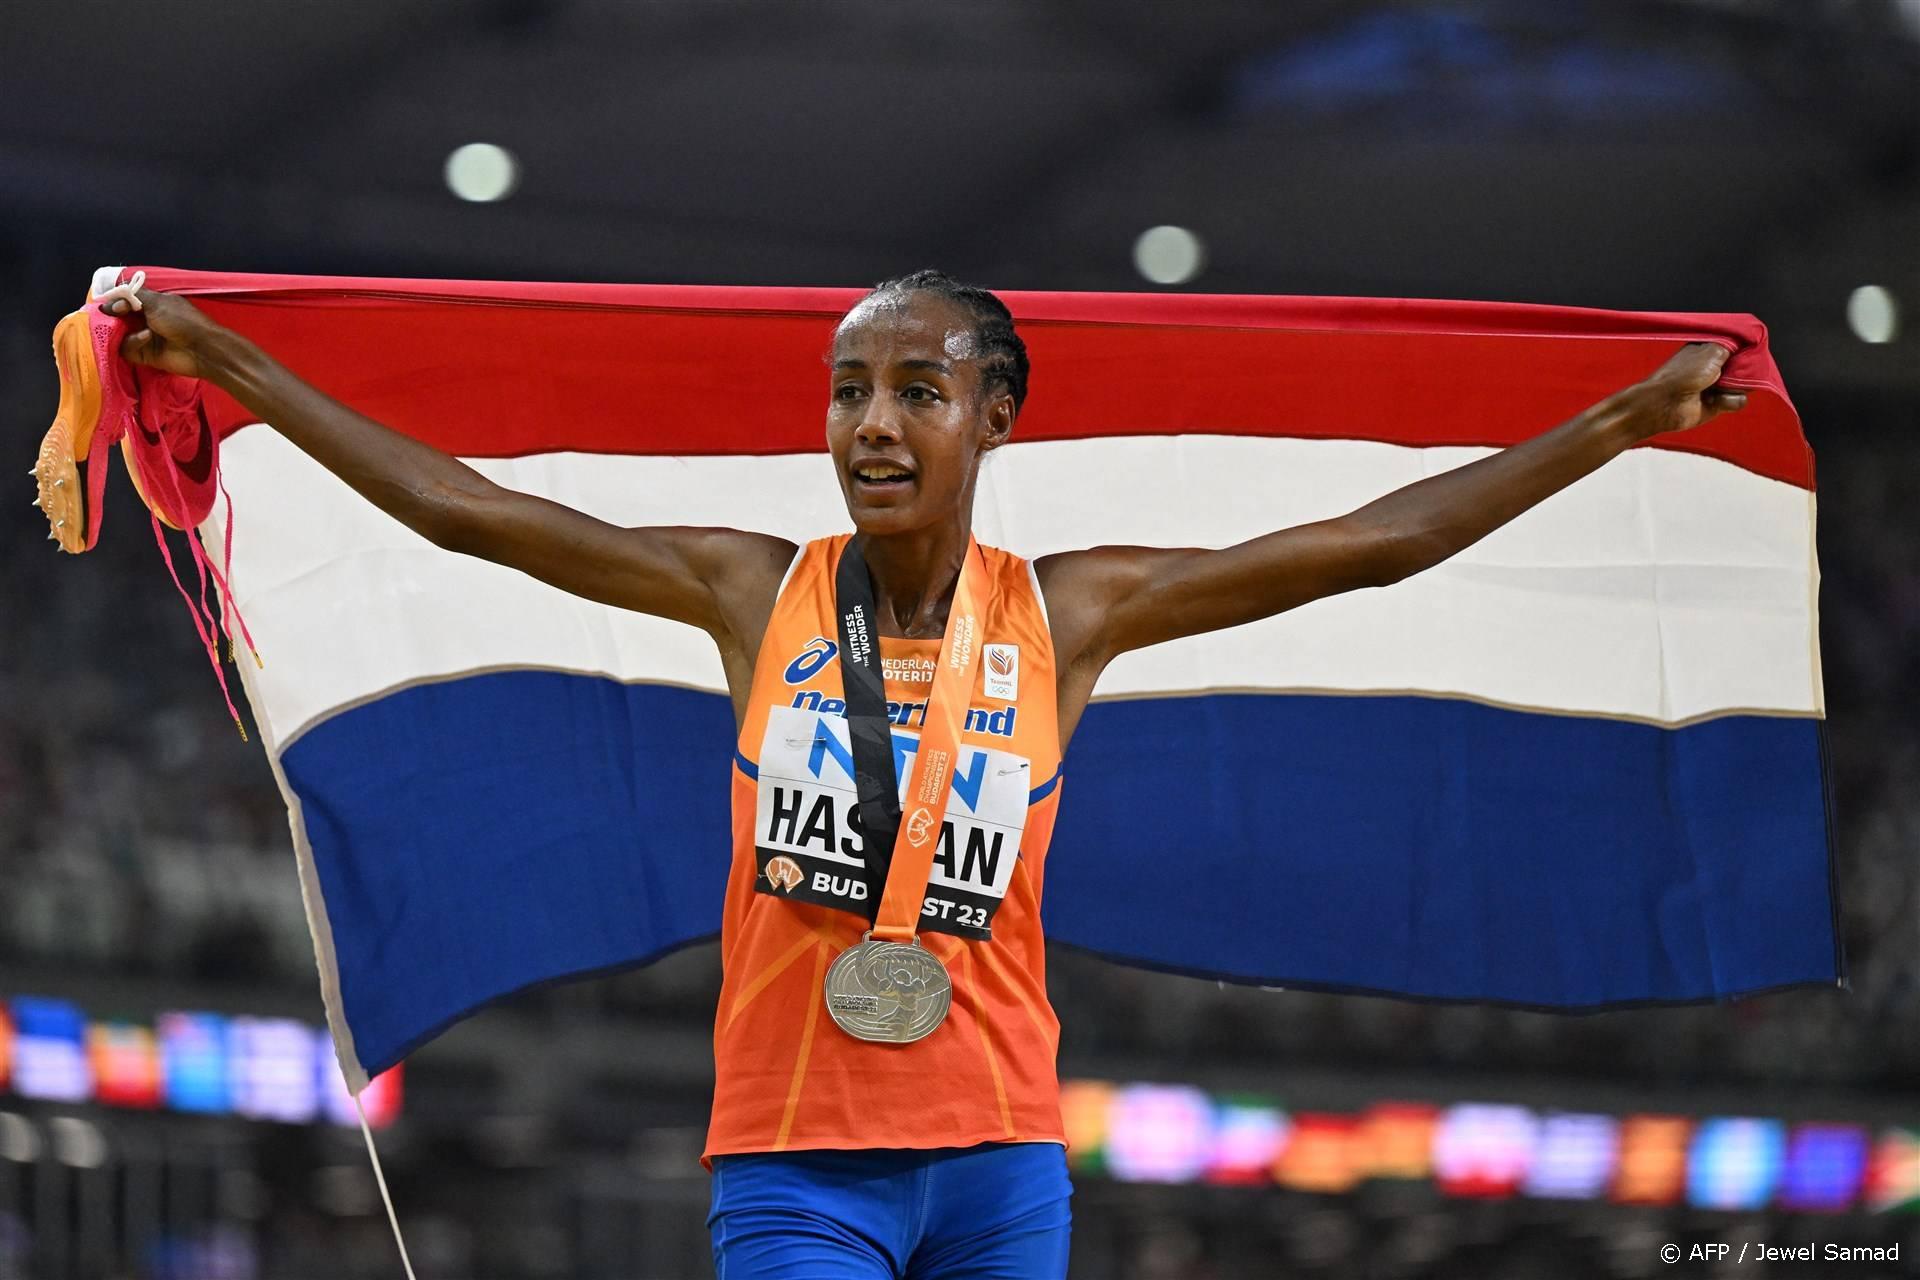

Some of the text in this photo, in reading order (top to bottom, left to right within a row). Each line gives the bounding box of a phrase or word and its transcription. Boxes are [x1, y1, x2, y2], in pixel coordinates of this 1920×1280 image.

[845, 613, 862, 663] WITNESS
[853, 604, 871, 667] THE WONDER
[950, 616, 964, 668] WITNESS
[960, 614, 974, 666] WONDER
[881, 658, 937, 670] NEDERLAN
[882, 669, 933, 682] OTERIJ
[930, 762, 944, 805] BUDAPEST
[768, 786, 1004, 887] HASAN
[811, 871, 988, 927] BUDST 23
